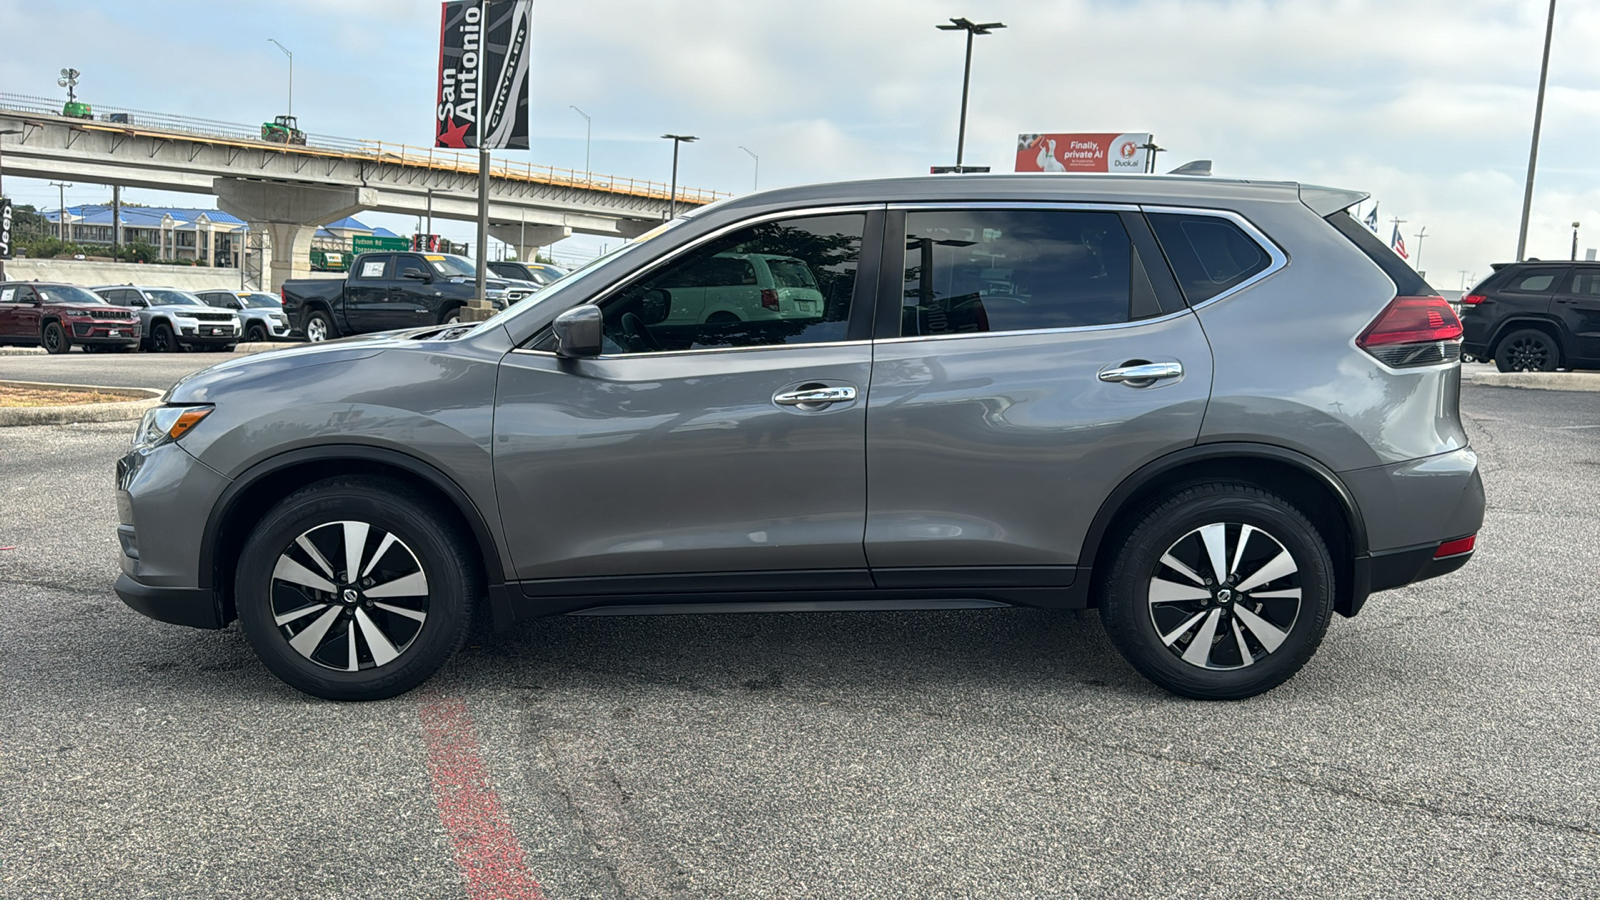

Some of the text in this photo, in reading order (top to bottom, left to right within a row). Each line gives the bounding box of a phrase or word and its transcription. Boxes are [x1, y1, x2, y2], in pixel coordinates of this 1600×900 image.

[455, 7, 480, 123] Antonio
[491, 29, 525, 128] CHRYSLER
[437, 68, 457, 122] San
[1064, 150, 1103, 160] private AI
[1070, 141, 1099, 150] Finally,
[0, 205, 12, 255] Jeep
[355, 238, 374, 246] Judson
